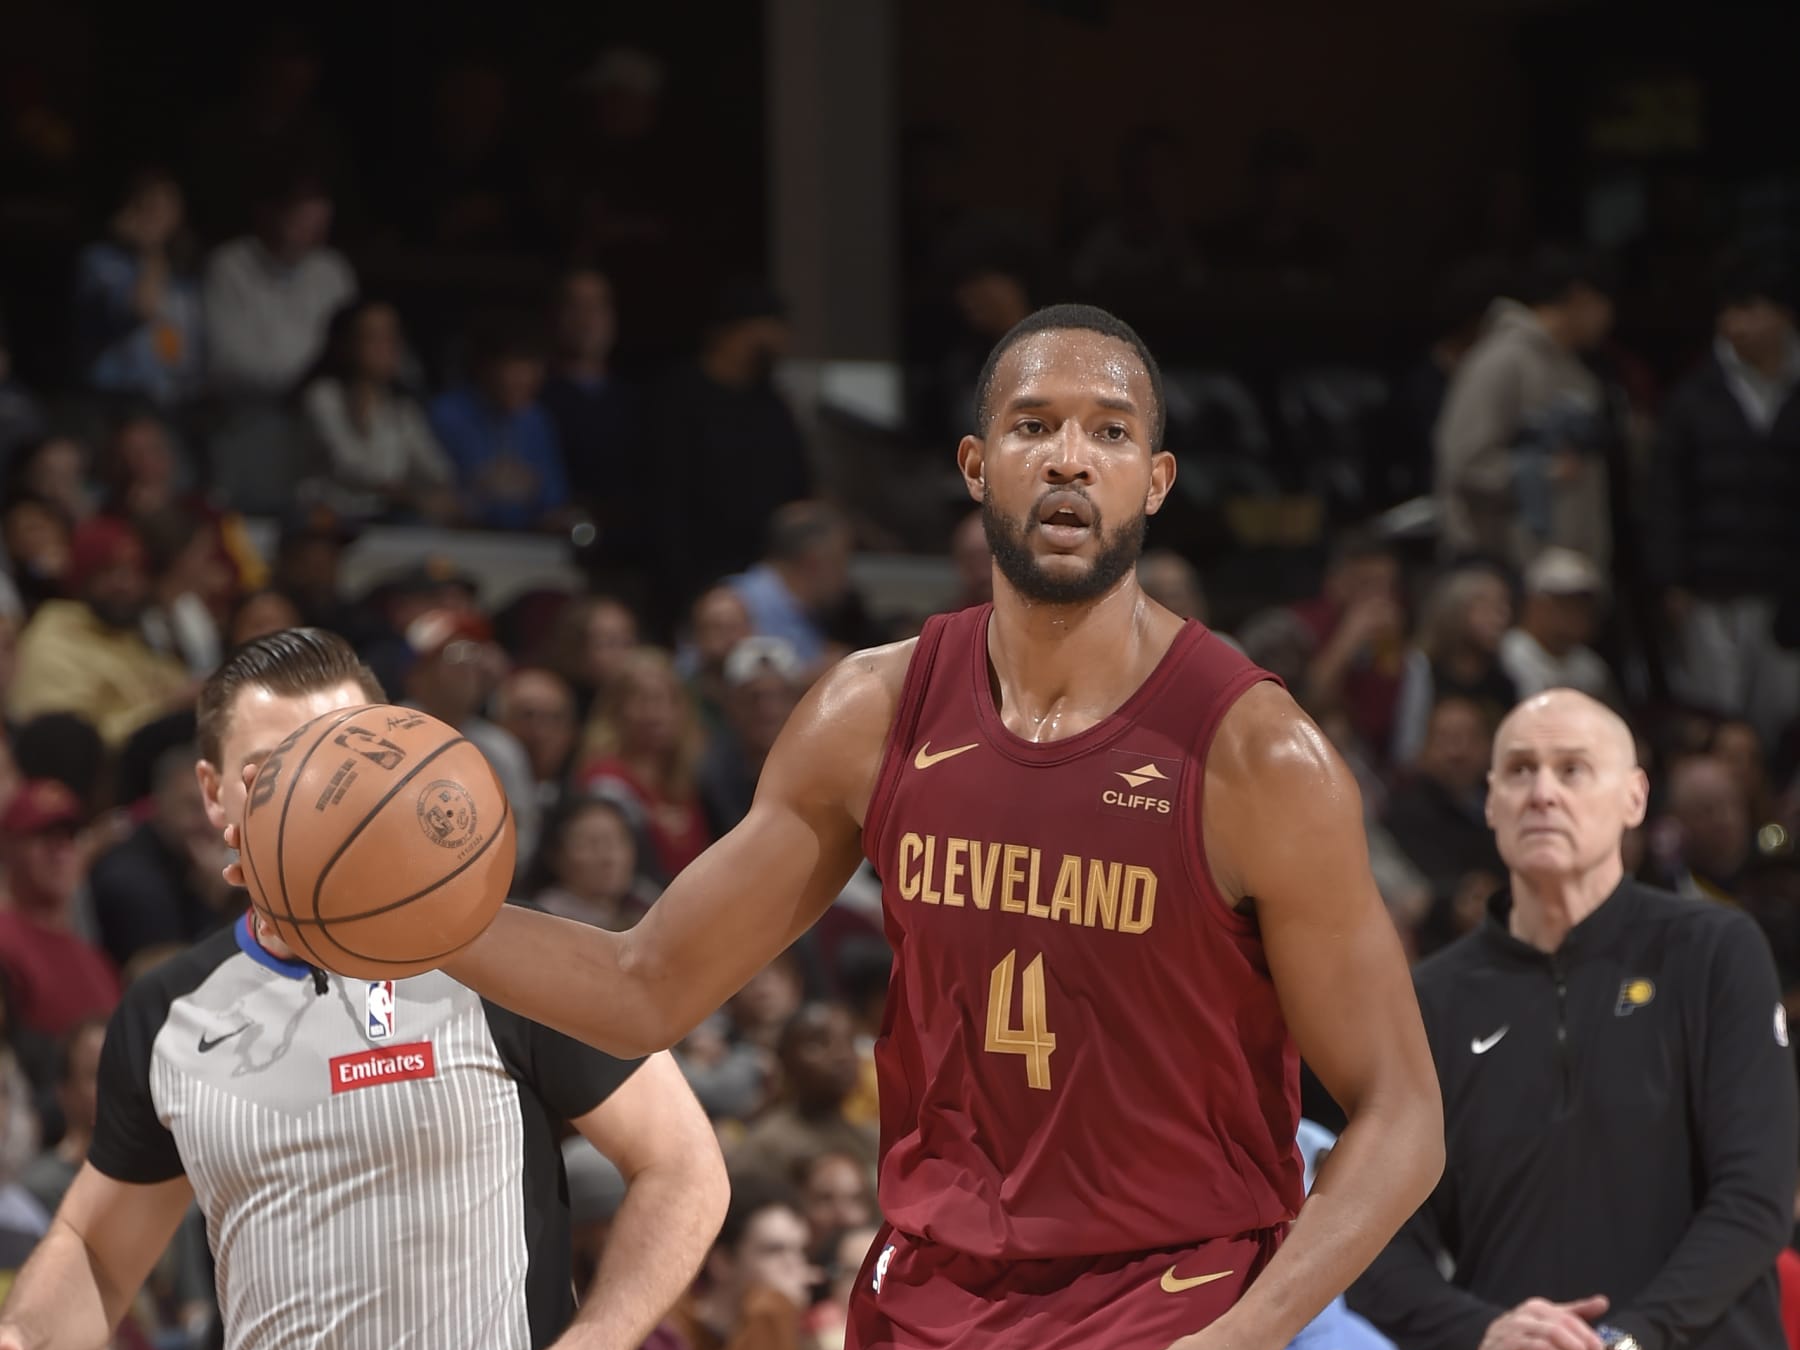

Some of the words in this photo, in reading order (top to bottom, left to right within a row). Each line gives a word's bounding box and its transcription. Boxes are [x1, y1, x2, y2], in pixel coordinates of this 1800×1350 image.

[1102, 790, 1170, 814] CLIFFS
[899, 832, 1158, 934] CLEVELAND
[984, 948, 1056, 1091] 4
[339, 1053, 425, 1083] Emirates
